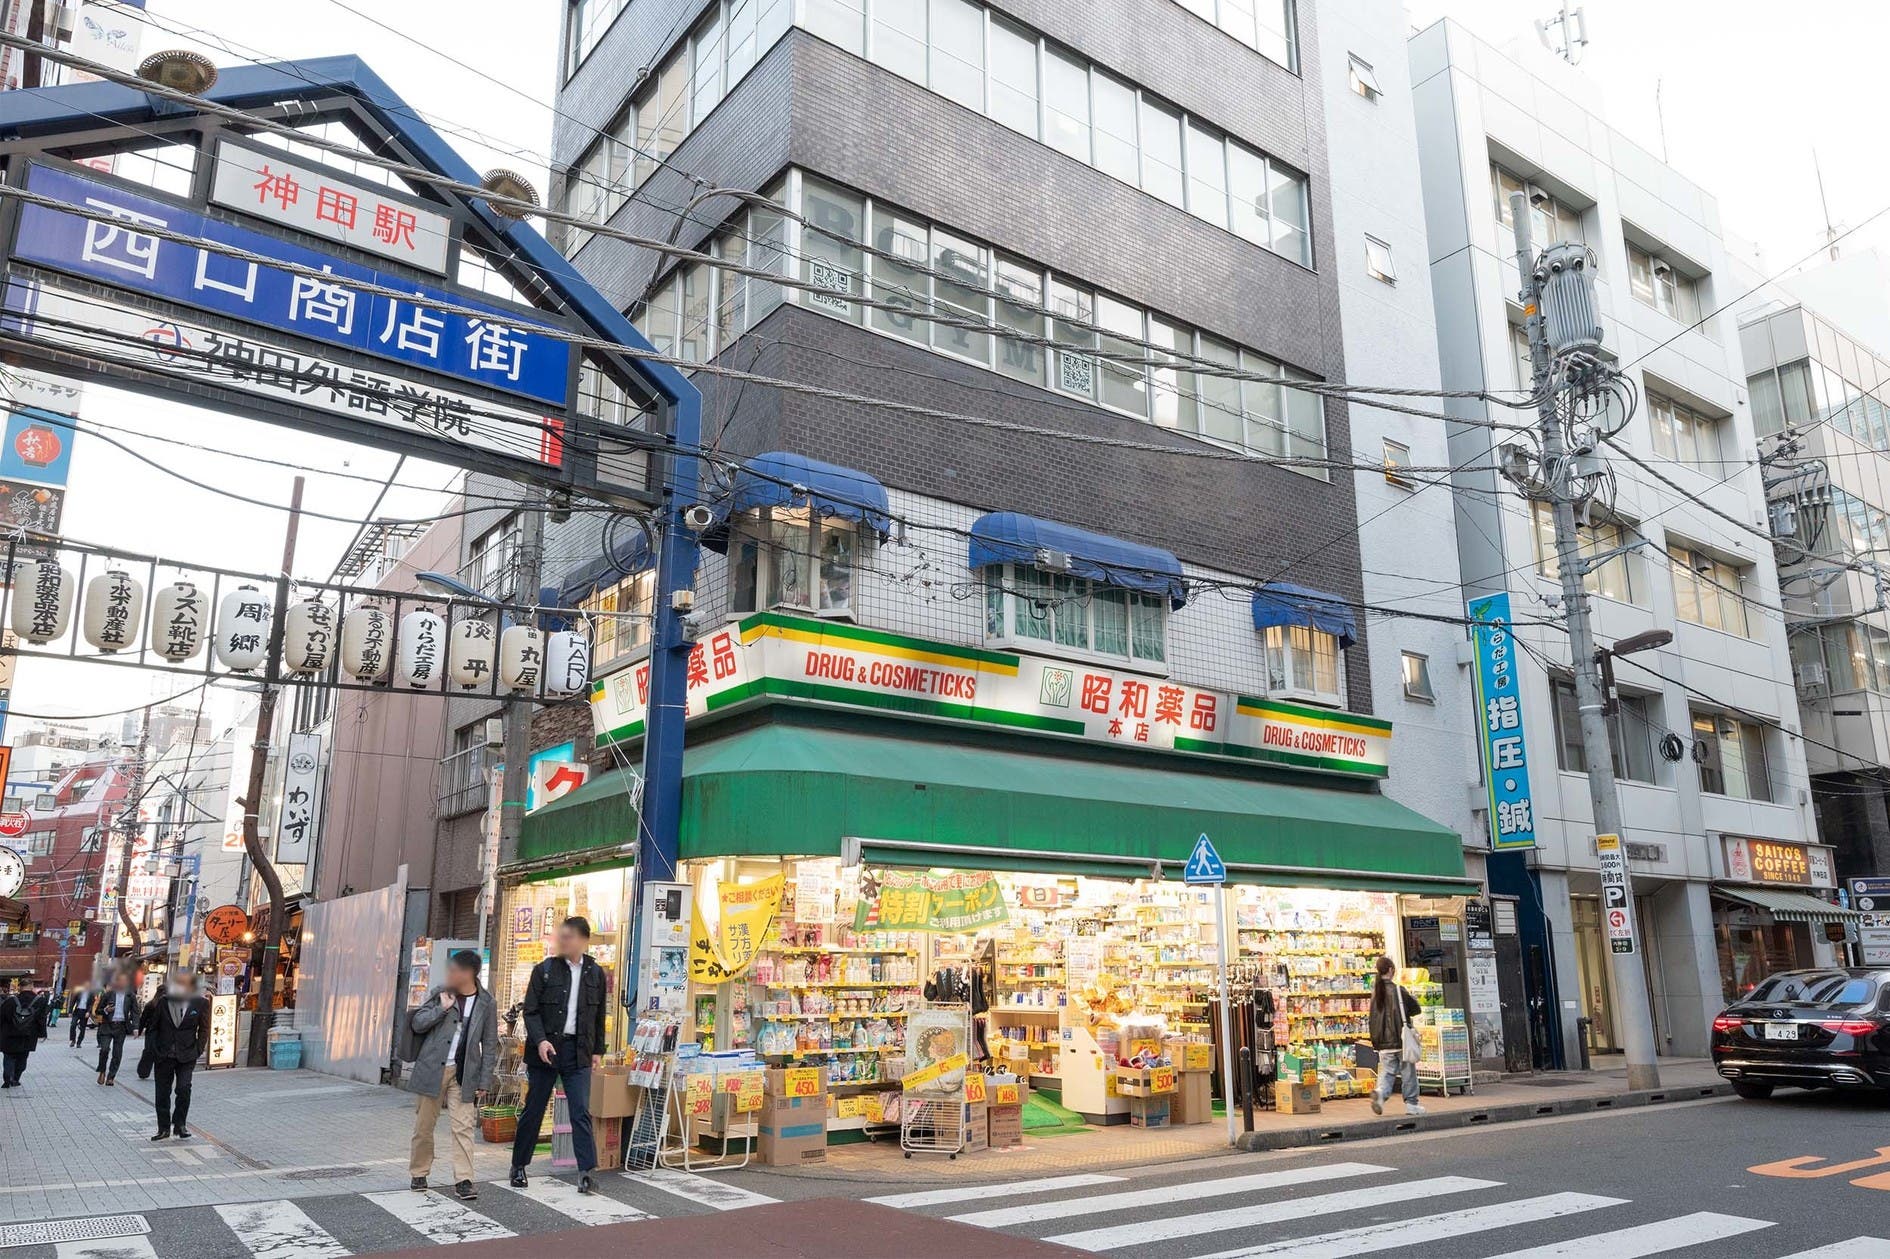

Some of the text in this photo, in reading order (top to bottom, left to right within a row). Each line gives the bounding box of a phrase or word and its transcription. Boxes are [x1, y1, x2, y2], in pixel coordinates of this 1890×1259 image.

[254, 164, 417, 251] 神田駅
[82, 197, 529, 382] 西口商店街
[203, 333, 471, 436] 神田外語学院
[30, 563, 62, 637] 昭和薬品本店
[165, 586, 202, 656] リズム靴店
[229, 602, 262, 653] 周郷
[300, 604, 333, 669] おせっかい屋
[411, 618, 437, 680] からだ工房
[463, 621, 491, 678] 淡平
[514, 646, 540, 687] 丸屋
[565, 637, 587, 691] HARU
[637, 631, 736, 705] 昭薬品
[805, 650, 976, 700] DRUG & COSMETICKS
[1081, 673, 1217, 732] 昭和薬品
[1108, 718, 1149, 743] 本店
[1263, 724, 1366, 757] DRUG & COSMETICKS
[1487, 697, 1534, 835] 指圧・鍼
[284, 785, 311, 844] わいず
[1754, 858, 1807, 873] COFFEE
[1755, 844, 1802, 861] SAITO'S
[1764, 871, 1783, 880] SINCE
[879, 886, 998, 925] 特割クーポン
[1606, 888, 1623, 908] P
[213, 1026, 225, 1058] わいず
[795, 1081, 814, 1095] 450
[1157, 1074, 1173, 1089] 500
